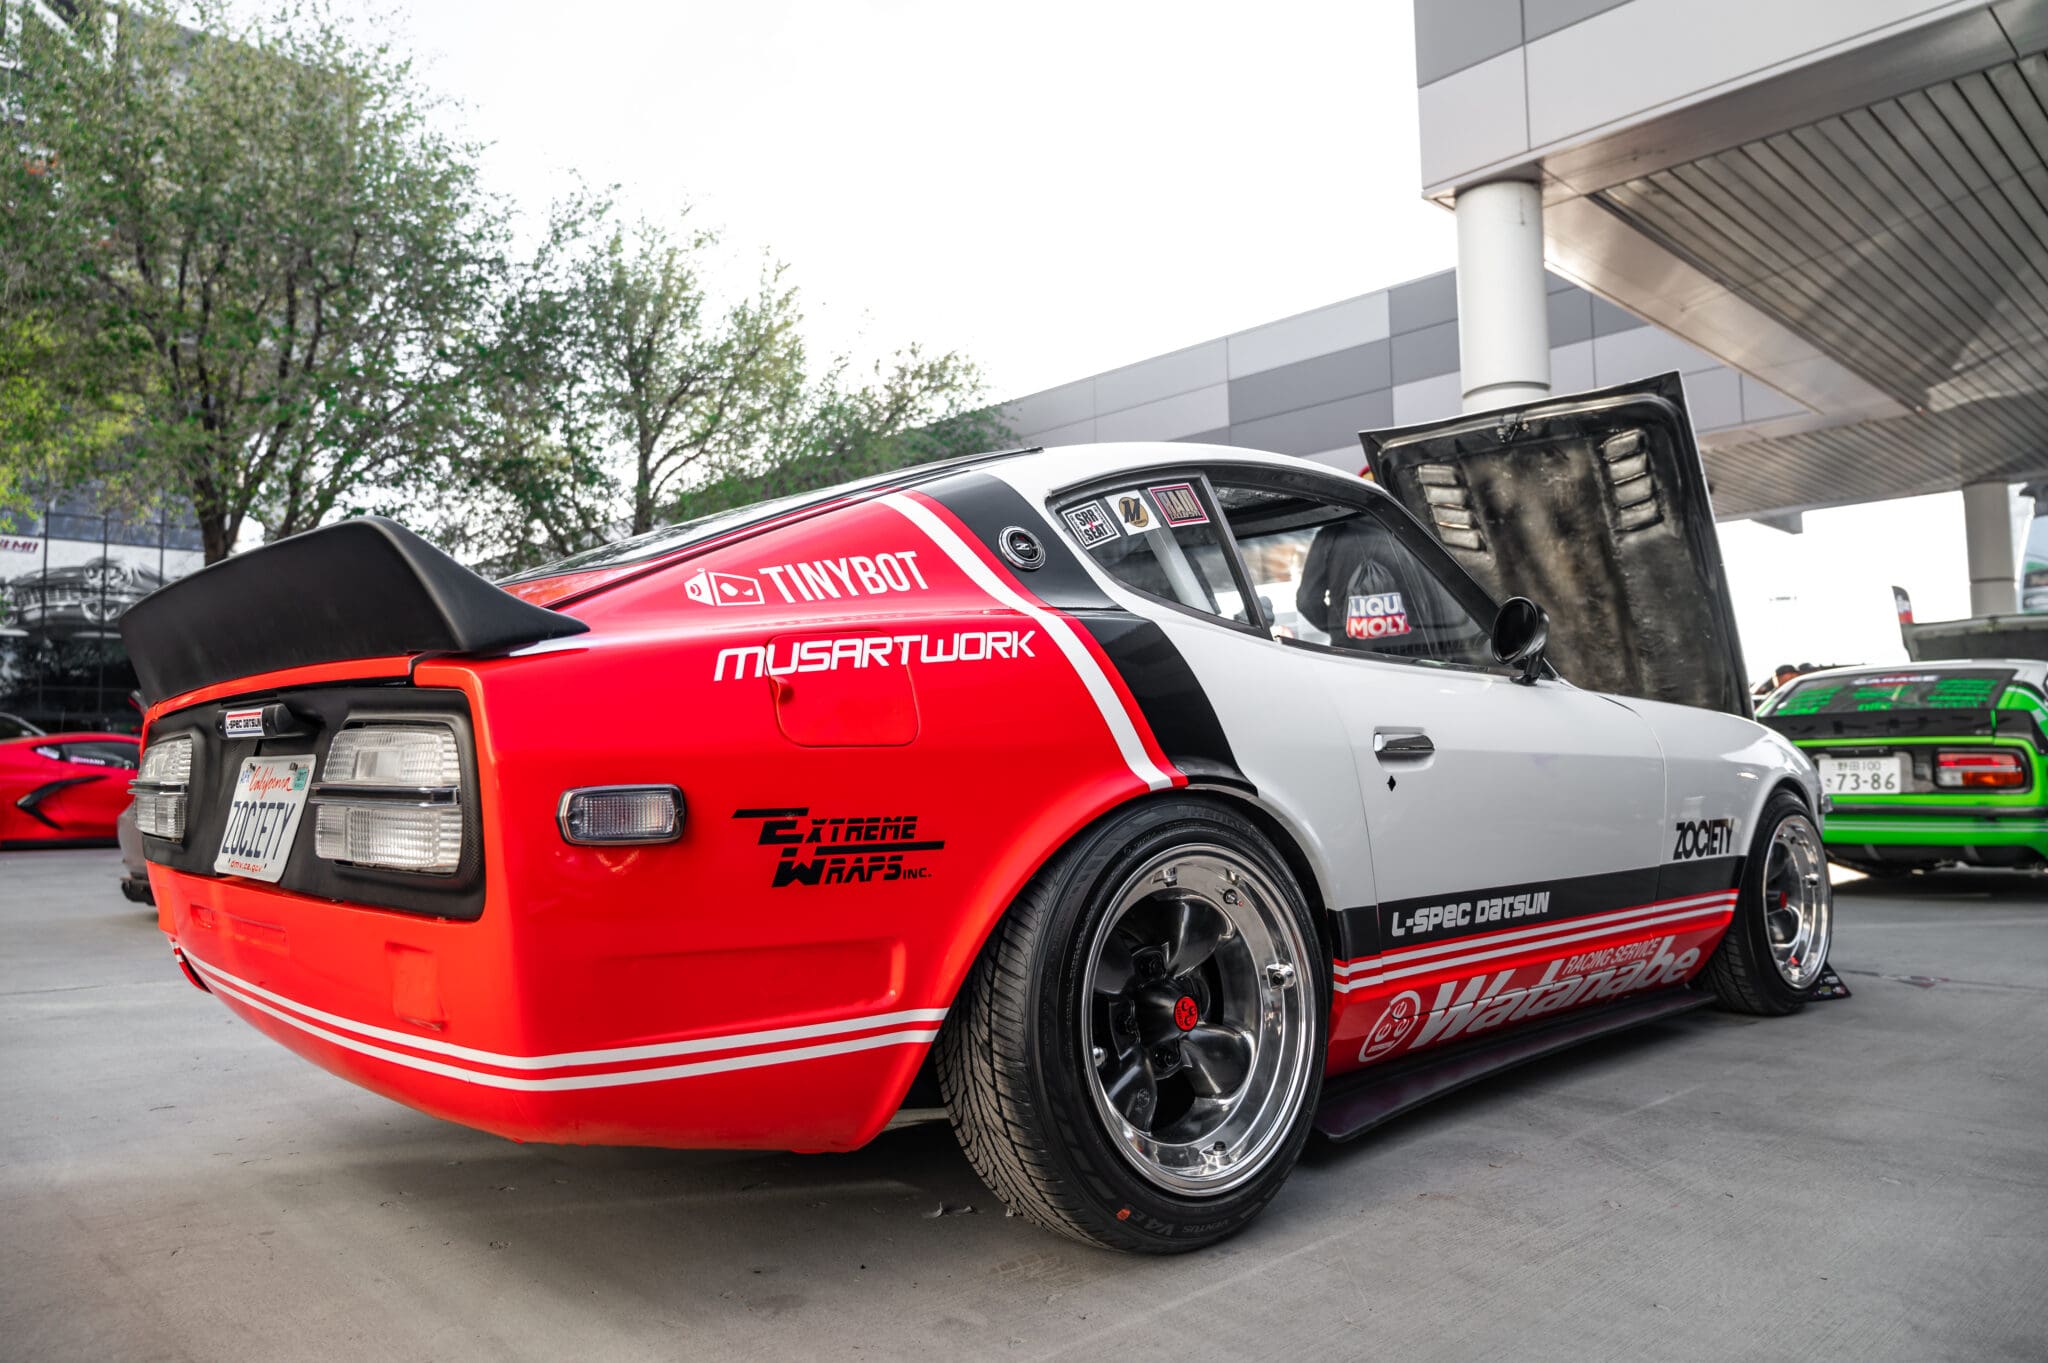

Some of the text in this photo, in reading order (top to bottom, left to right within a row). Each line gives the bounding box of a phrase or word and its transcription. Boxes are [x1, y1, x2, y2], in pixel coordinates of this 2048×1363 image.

[758, 551, 929, 604] TINYBOT
[1350, 615, 1405, 637] MOLY
[713, 630, 1036, 681] MUSARTWORK
[248, 766, 293, 800] California
[1836, 772, 1895, 791] 73-86
[222, 801, 296, 860] ZOCIETY
[731, 807, 918, 846] EXTREME
[1673, 818, 1735, 860] ZOCIETY
[771, 848, 933, 888] WRAPS INC.
[1562, 937, 1662, 975] RACING SERVICE
[1406, 935, 1700, 1050] Watanabe
